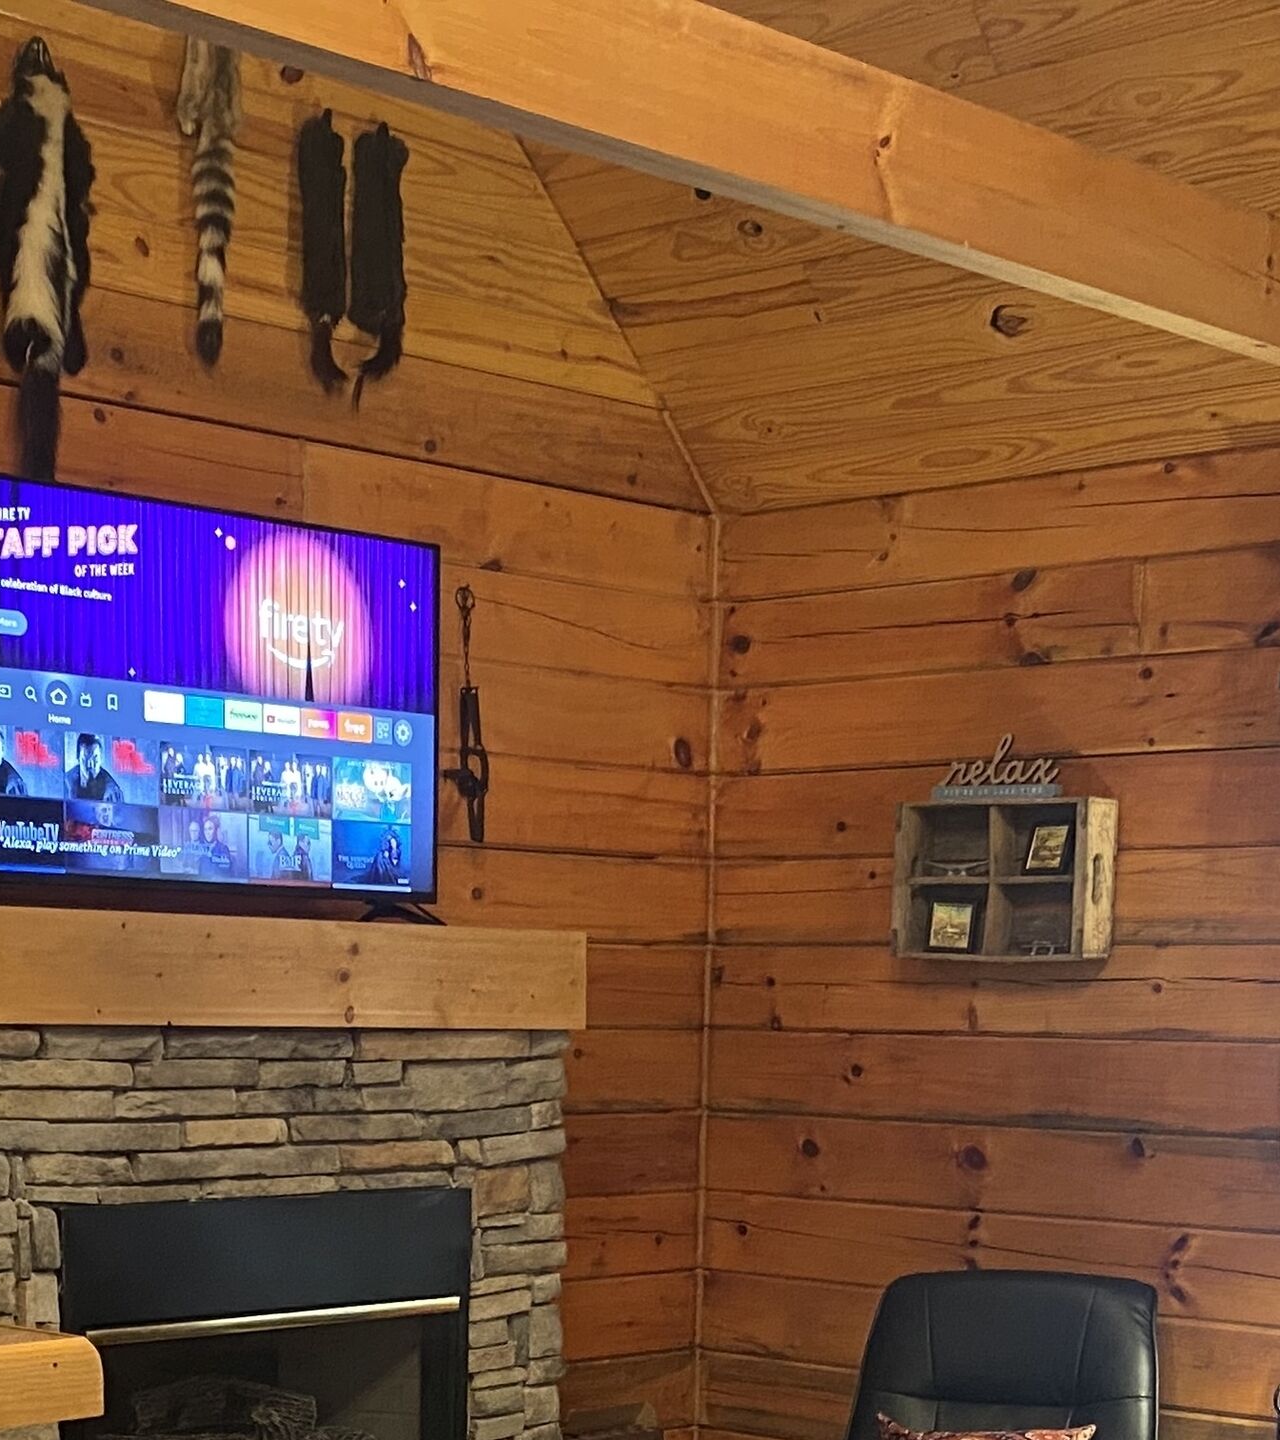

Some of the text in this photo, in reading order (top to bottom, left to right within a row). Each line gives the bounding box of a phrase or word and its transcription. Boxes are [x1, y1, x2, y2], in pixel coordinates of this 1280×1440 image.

[17, 506, 31, 520] TV
[67, 524, 138, 557] PICK
[74, 562, 135, 578] OF THE WEEK
[0, 577, 48, 593] celebration
[49, 583, 59, 595] of
[59, 584, 82, 598] Black
[83, 588, 112, 602] culture
[48, 713, 71, 725] Home
[940, 732, 1060, 787] relax
[35, 838, 59, 854] play
[59, 839, 108, 857] something
[109, 845, 121, 854] on
[123, 843, 150, 856] Prime
